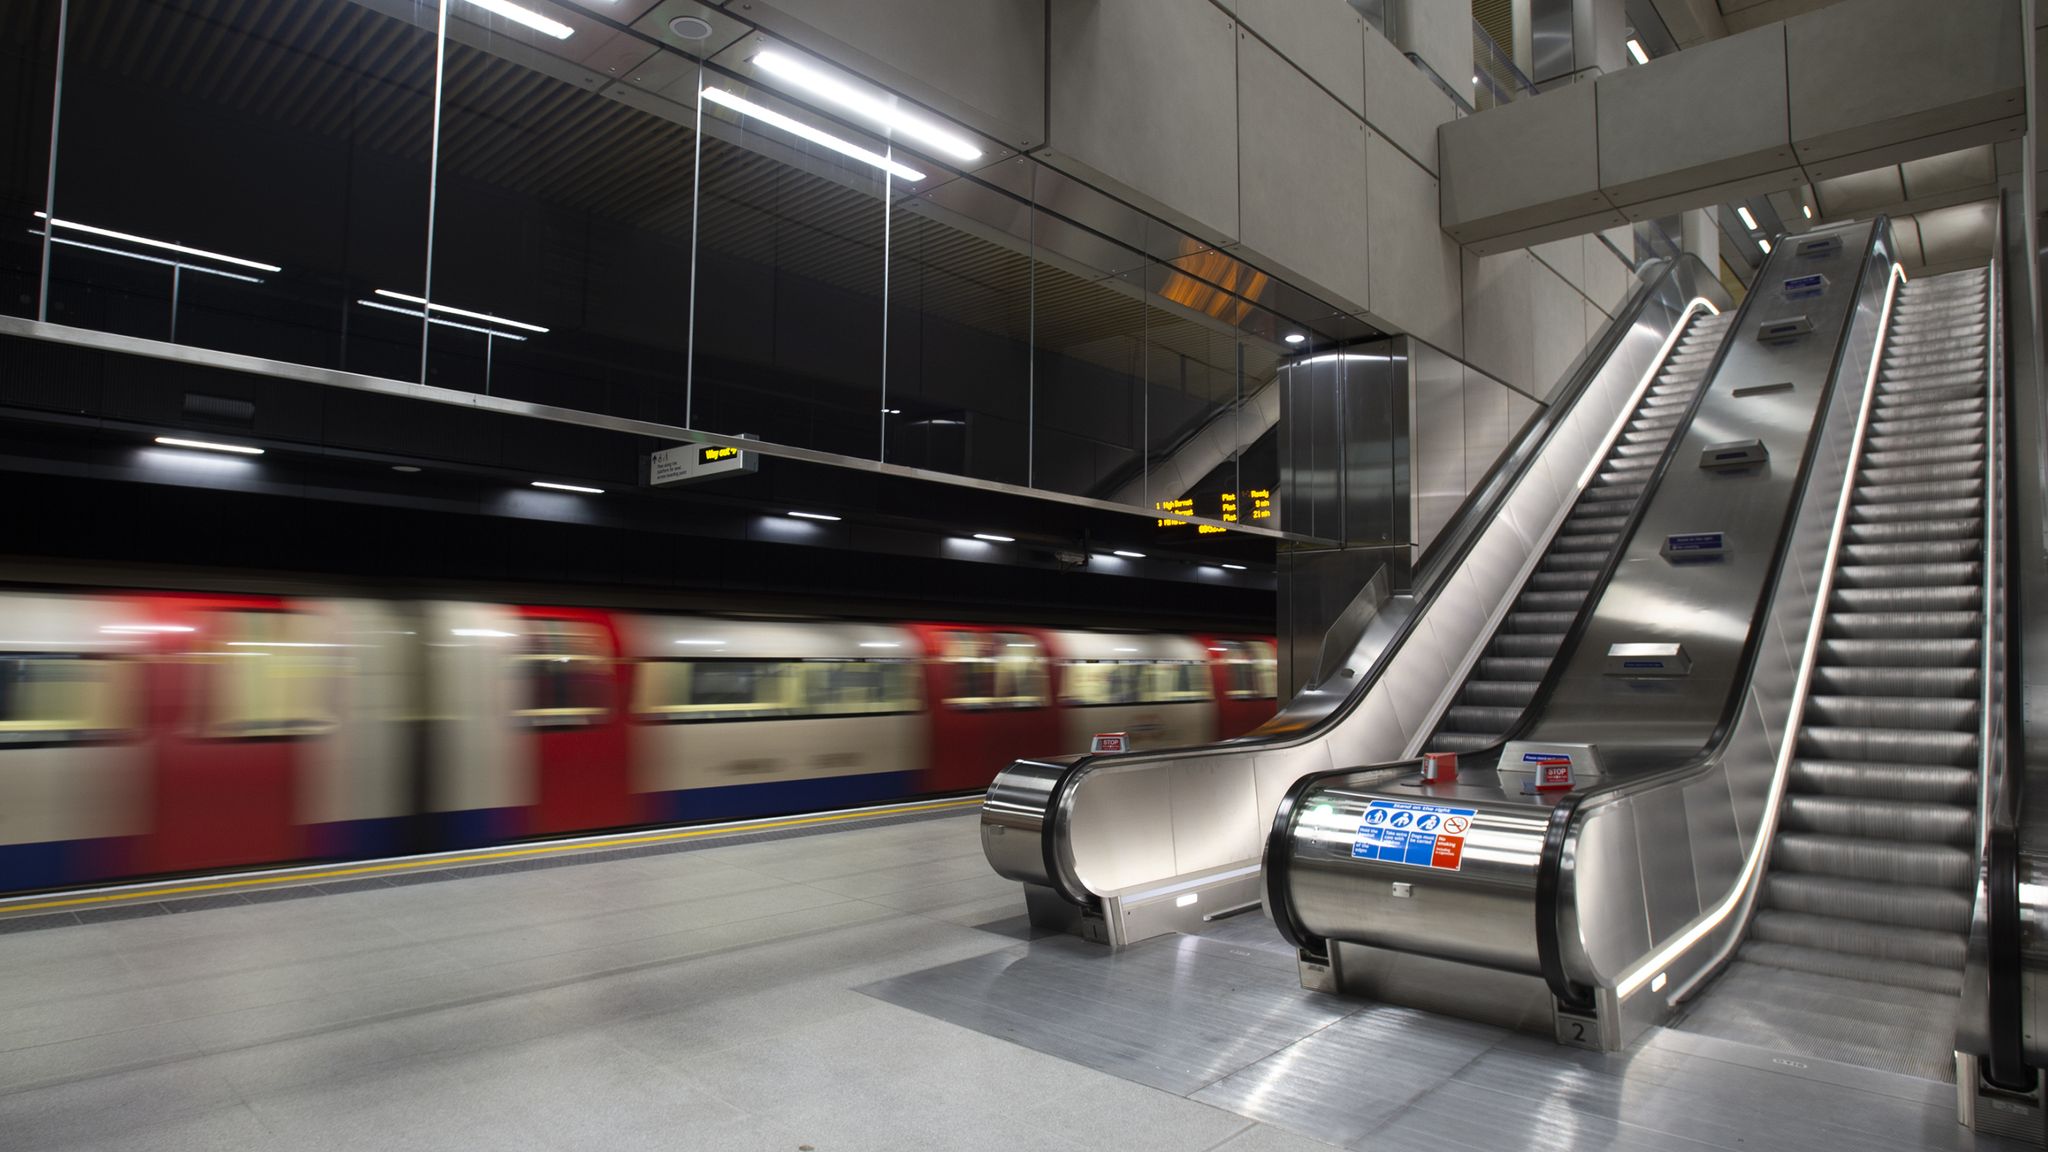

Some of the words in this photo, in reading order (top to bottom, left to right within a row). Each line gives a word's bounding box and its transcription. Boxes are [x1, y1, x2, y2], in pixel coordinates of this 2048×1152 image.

[706, 449, 719, 460] Way
[719, 447, 731, 457] out
[1571, 1022, 1586, 1042] 2
